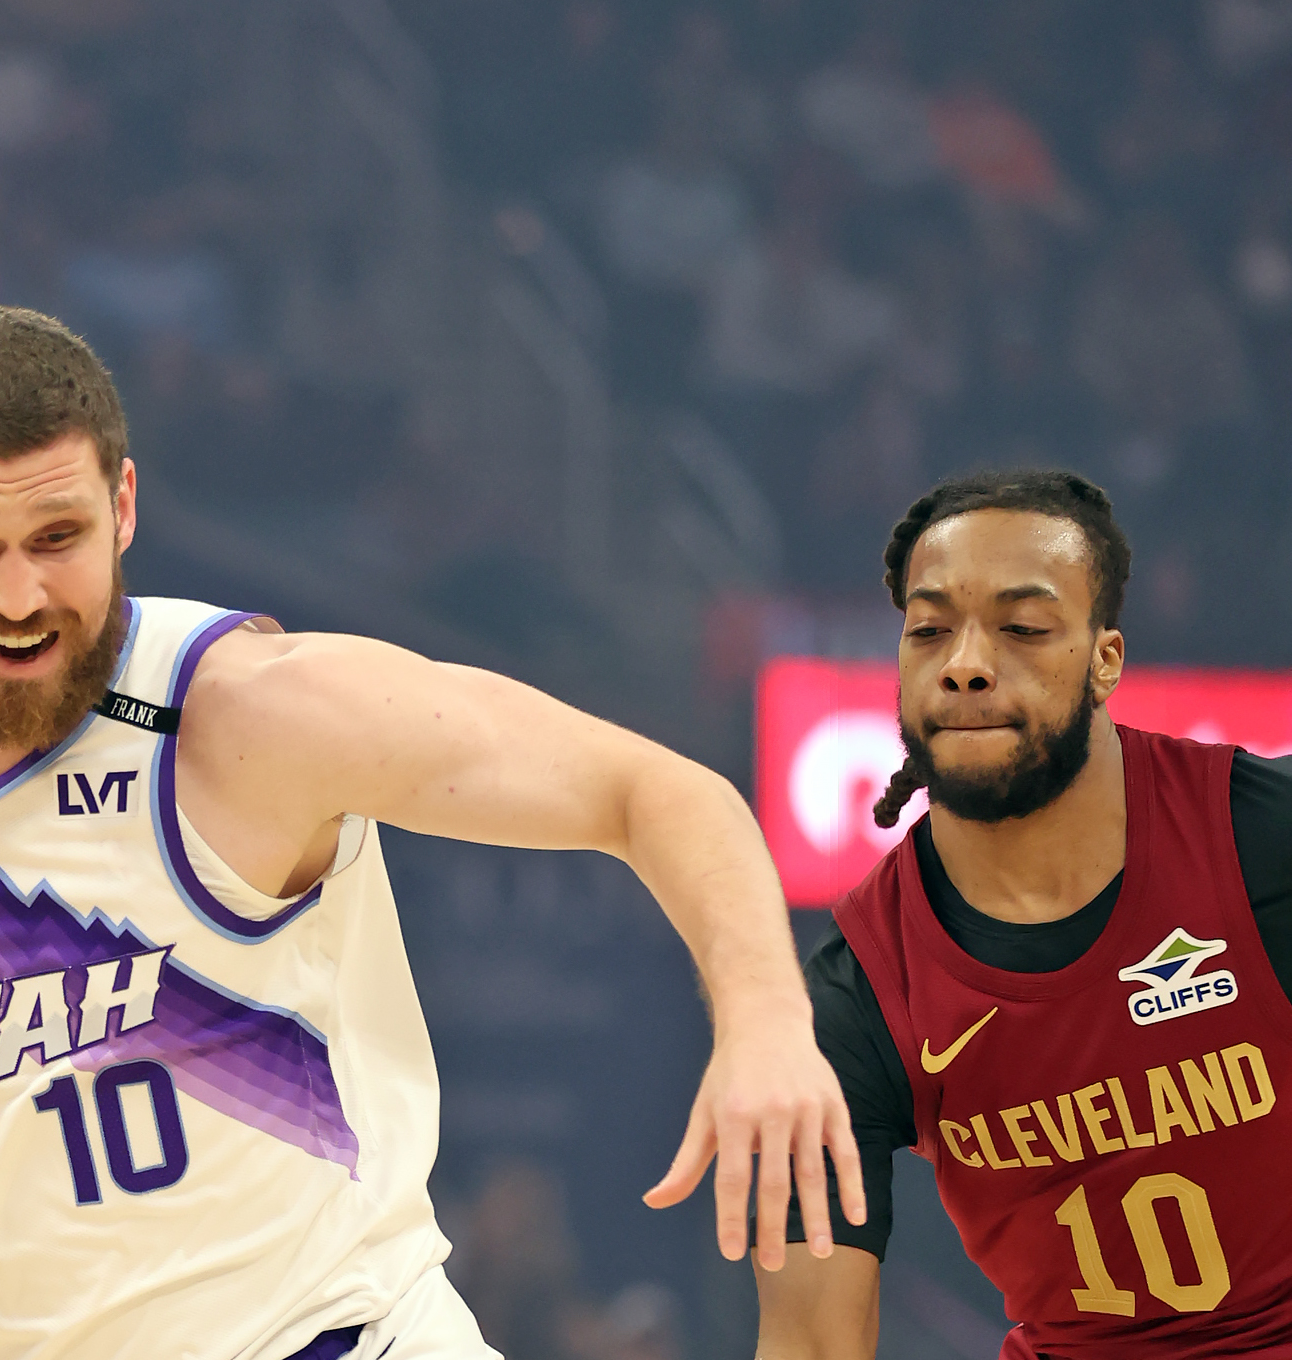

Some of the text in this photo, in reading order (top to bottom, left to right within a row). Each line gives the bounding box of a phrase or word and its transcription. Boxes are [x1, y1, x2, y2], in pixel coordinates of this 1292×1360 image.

[110, 697, 158, 727] FRANK
[56, 770, 138, 816] LVT
[1133, 977, 1234, 1018] CLIFFS
[31, 1058, 189, 1207] 10
[939, 1042, 1277, 1171] CLEVELAND
[1054, 1172, 1231, 1318] 10
